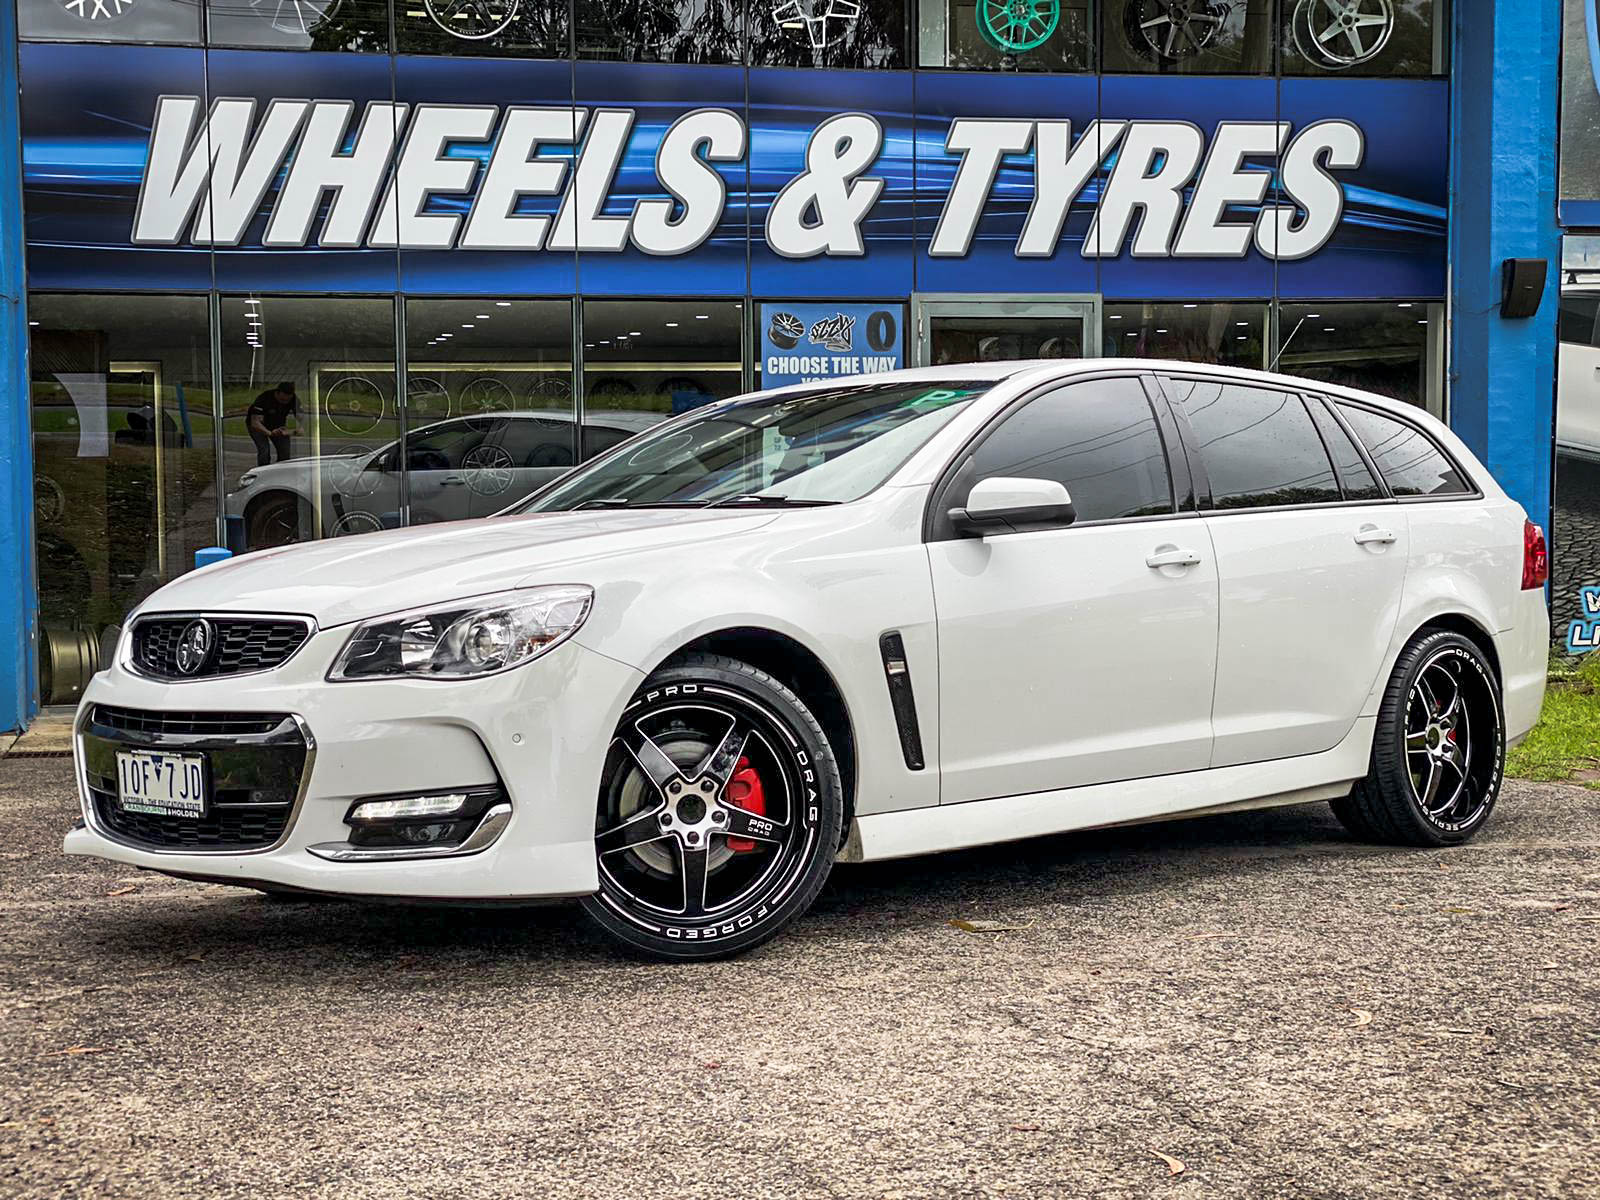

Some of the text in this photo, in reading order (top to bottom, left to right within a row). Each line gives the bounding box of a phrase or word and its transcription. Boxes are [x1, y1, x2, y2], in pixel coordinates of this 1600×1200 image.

[131, 95, 1365, 261] WHEELS & TYRES
[767, 356, 897, 375] CHOOSE THE WAY
[1455, 649, 1482, 674] DRAG
[647, 684, 698, 702] PRO
[796, 750, 818, 822] DRAG
[172, 808, 200, 819] HOLDEN
[748, 818, 774, 831] PRO
[666, 905, 769, 939] FORGED
